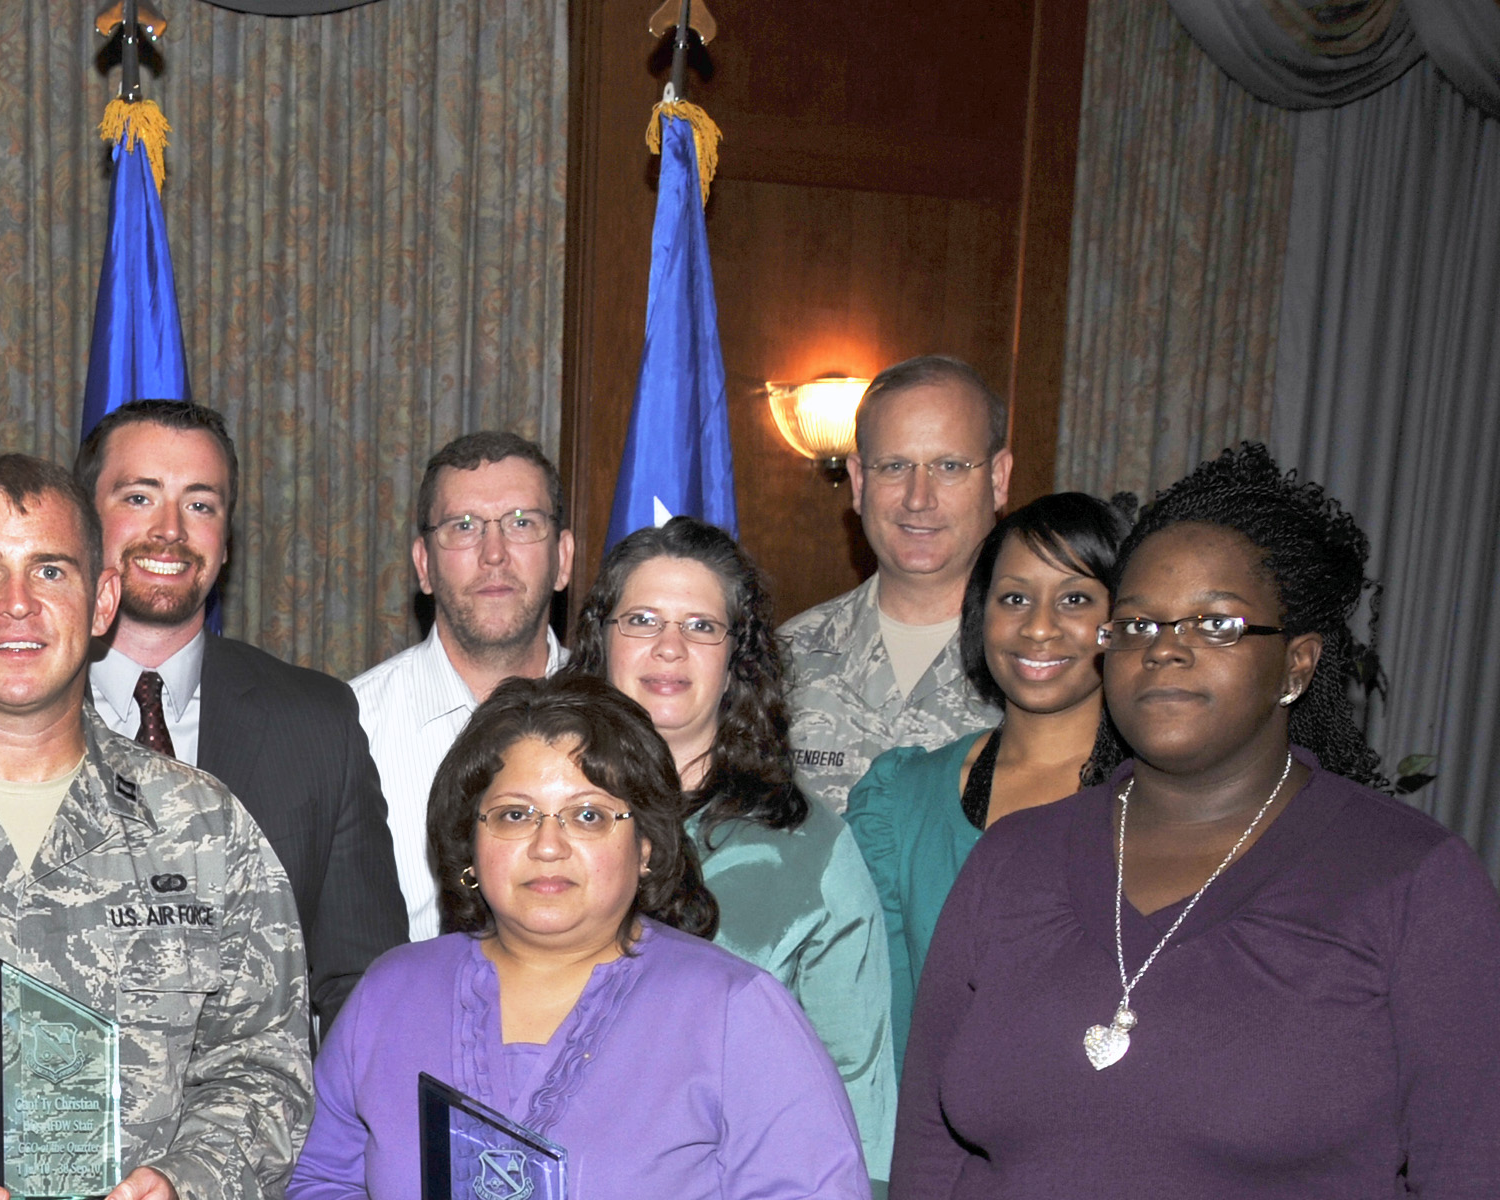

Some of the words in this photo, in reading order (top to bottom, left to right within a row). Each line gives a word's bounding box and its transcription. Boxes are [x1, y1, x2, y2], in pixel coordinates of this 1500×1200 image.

[110, 907, 142, 927] U.S.
[146, 906, 176, 926] AIR
[177, 904, 214, 926] FORCE
[40, 1097, 53, 1114] Ty
[54, 1095, 100, 1112] Christian
[73, 1118, 94, 1133] Staff
[70, 1162, 87, 1179] Sep
